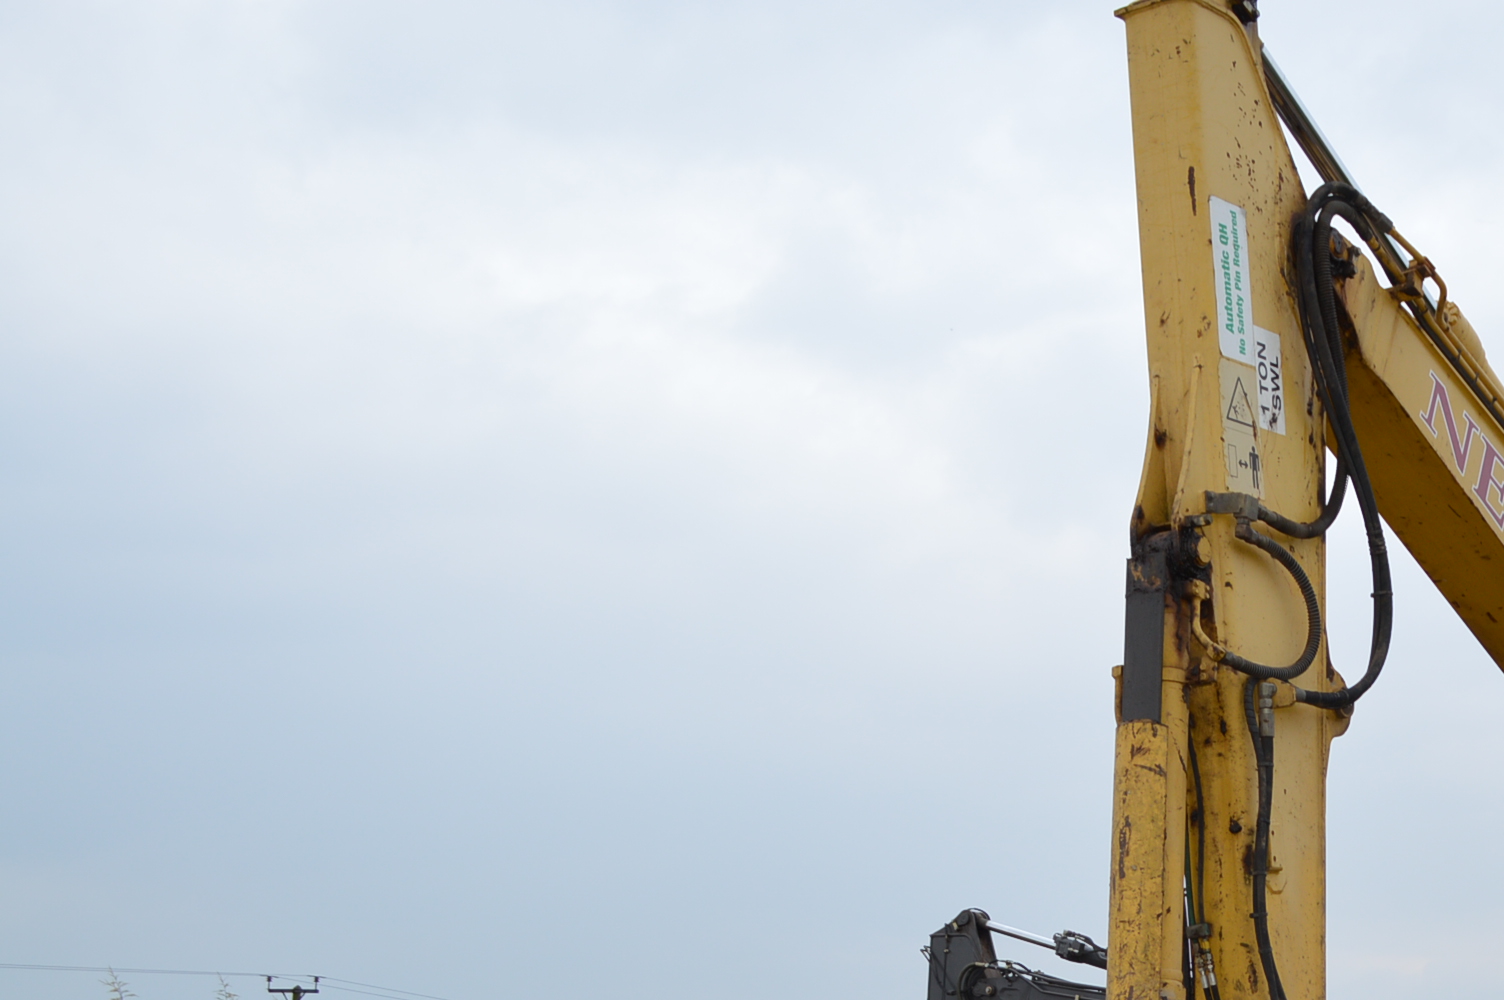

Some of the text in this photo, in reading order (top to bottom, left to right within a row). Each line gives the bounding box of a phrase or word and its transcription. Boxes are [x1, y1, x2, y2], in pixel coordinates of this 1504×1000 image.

[1218, 223, 1235, 335] Automatic QH
[1230, 210, 1246, 355] No Safety Pin Required
[1256, 341, 1270, 415] 1 TON
[1270, 356, 1282, 412] SWL
